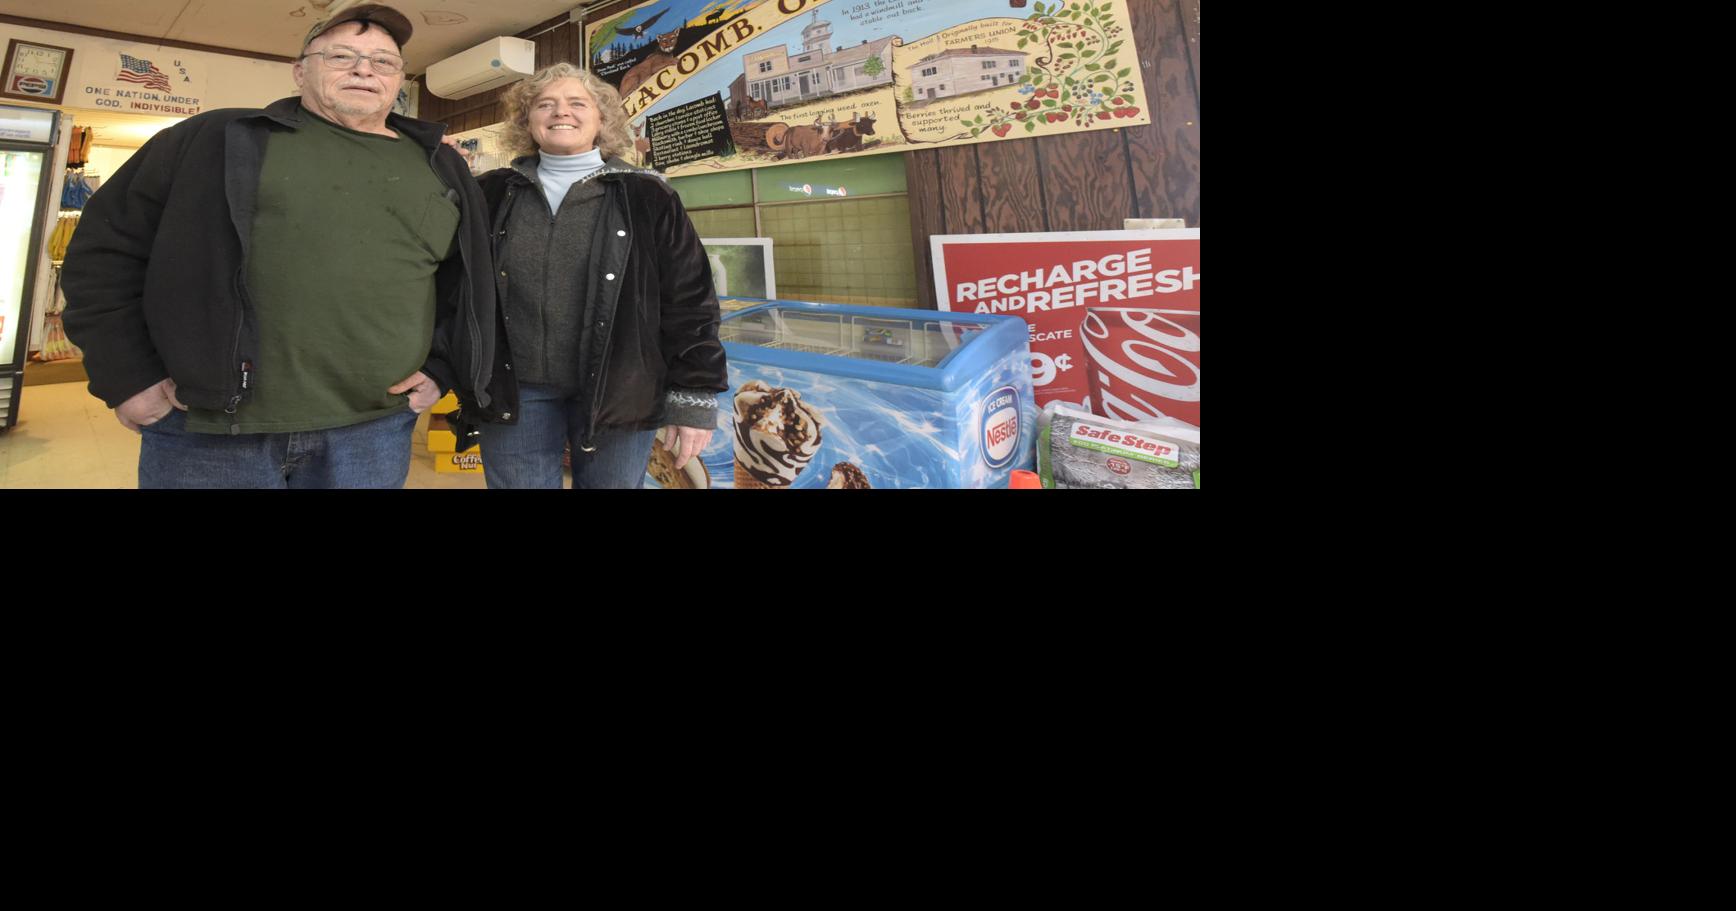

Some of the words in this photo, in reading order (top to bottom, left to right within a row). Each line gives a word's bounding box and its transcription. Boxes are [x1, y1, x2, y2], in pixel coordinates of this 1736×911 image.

[849, 12, 863, 21] had
[870, 2, 904, 16] windmill
[886, 11, 900, 19] out
[941, 25, 978, 39] Originally
[944, 33, 986, 46] FARMERS
[989, 26, 1017, 38] UNION
[85, 86, 111, 96] ONE
[163, 95, 200, 106] UNDER
[130, 101, 201, 115] INDIVISIBLE!
[703, 109, 717, 118] office
[939, 104, 971, 115] thrived
[974, 101, 991, 111] and
[911, 114, 961, 127] supported
[956, 248, 1152, 302] RECHARGE
[974, 297, 1026, 314] AND
[996, 394, 1013, 406] CREAM
